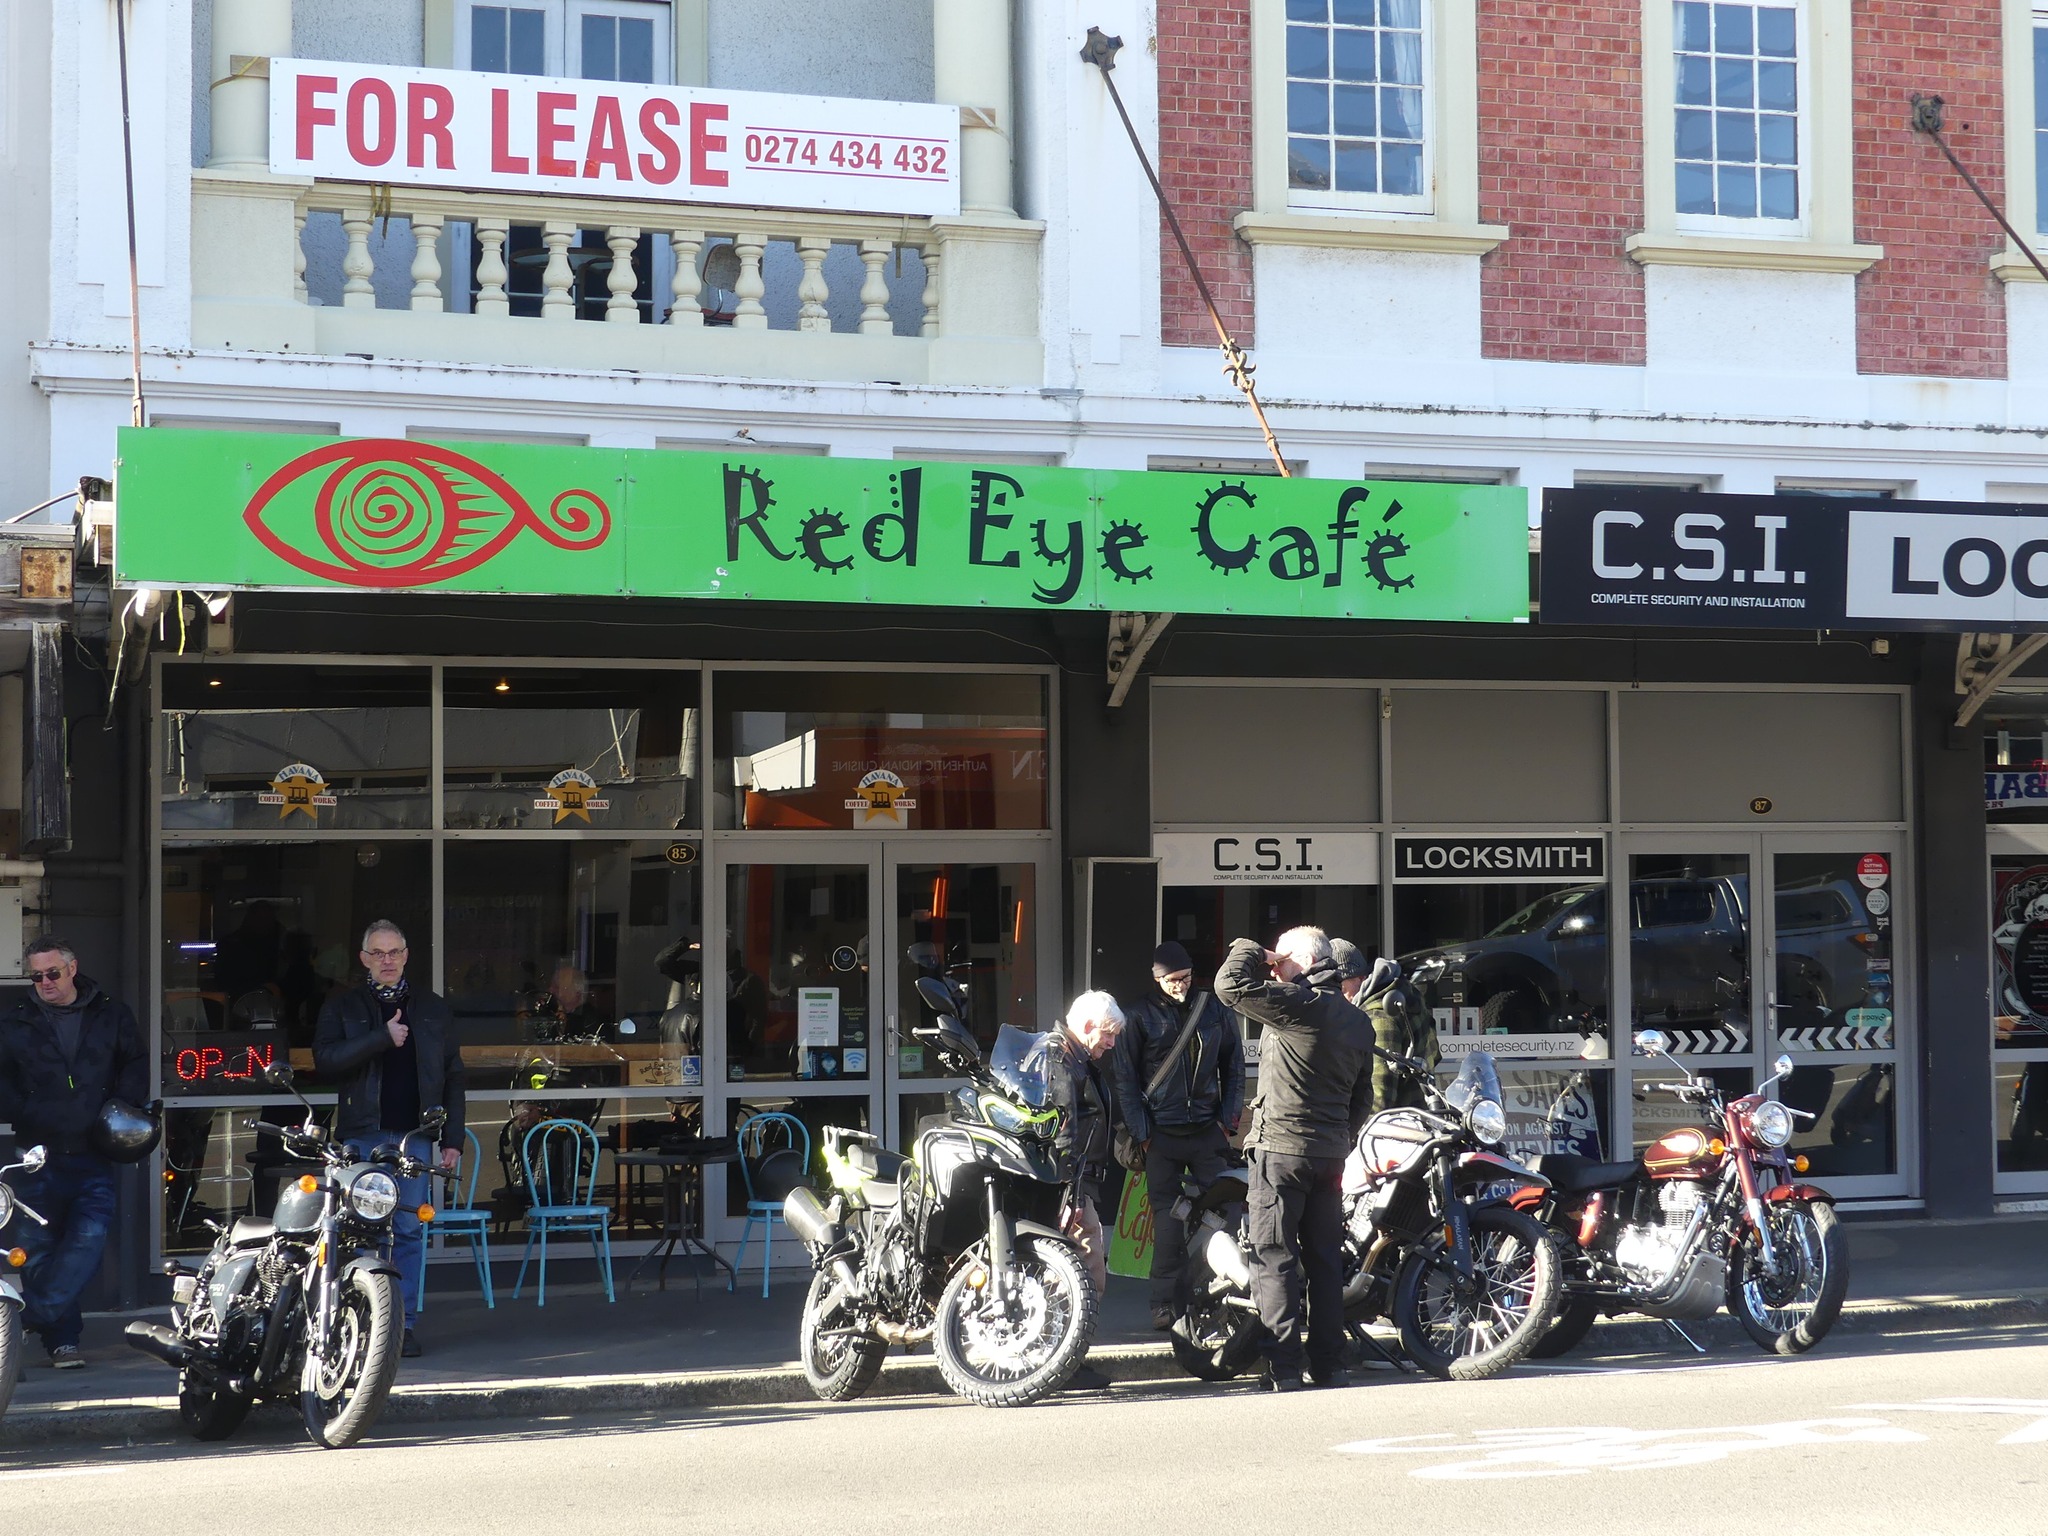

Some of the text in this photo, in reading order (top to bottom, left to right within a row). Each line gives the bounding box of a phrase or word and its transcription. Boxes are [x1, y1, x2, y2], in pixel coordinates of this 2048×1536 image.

[294, 75, 948, 188] FOR LEASE 0274 434 432
[722, 461, 1416, 605] Red Eye Café
[1591, 509, 1806, 585] C.S.I.
[1590, 593, 1806, 610] COMPLETE SECURITY AND INSTALLATION
[278, 763, 320, 783] HAVANA
[552, 770, 594, 787] HAVANA
[861, 772, 900, 786] HAVANA
[259, 794, 337, 805] COFFEE WORKS
[535, 799, 610, 808] COFFEE WORKS
[845, 799, 917, 809] COFFEE WORKS
[1754, 800, 1767, 811] 87
[671, 847, 687, 860] 85
[1213, 837, 1324, 872] C.S.I.
[1406, 845, 1593, 870] LOCKSMITH
[1439, 1039, 1574, 1054] completesecurity.nz
[1525, 1122, 1565, 1136] AGAST
